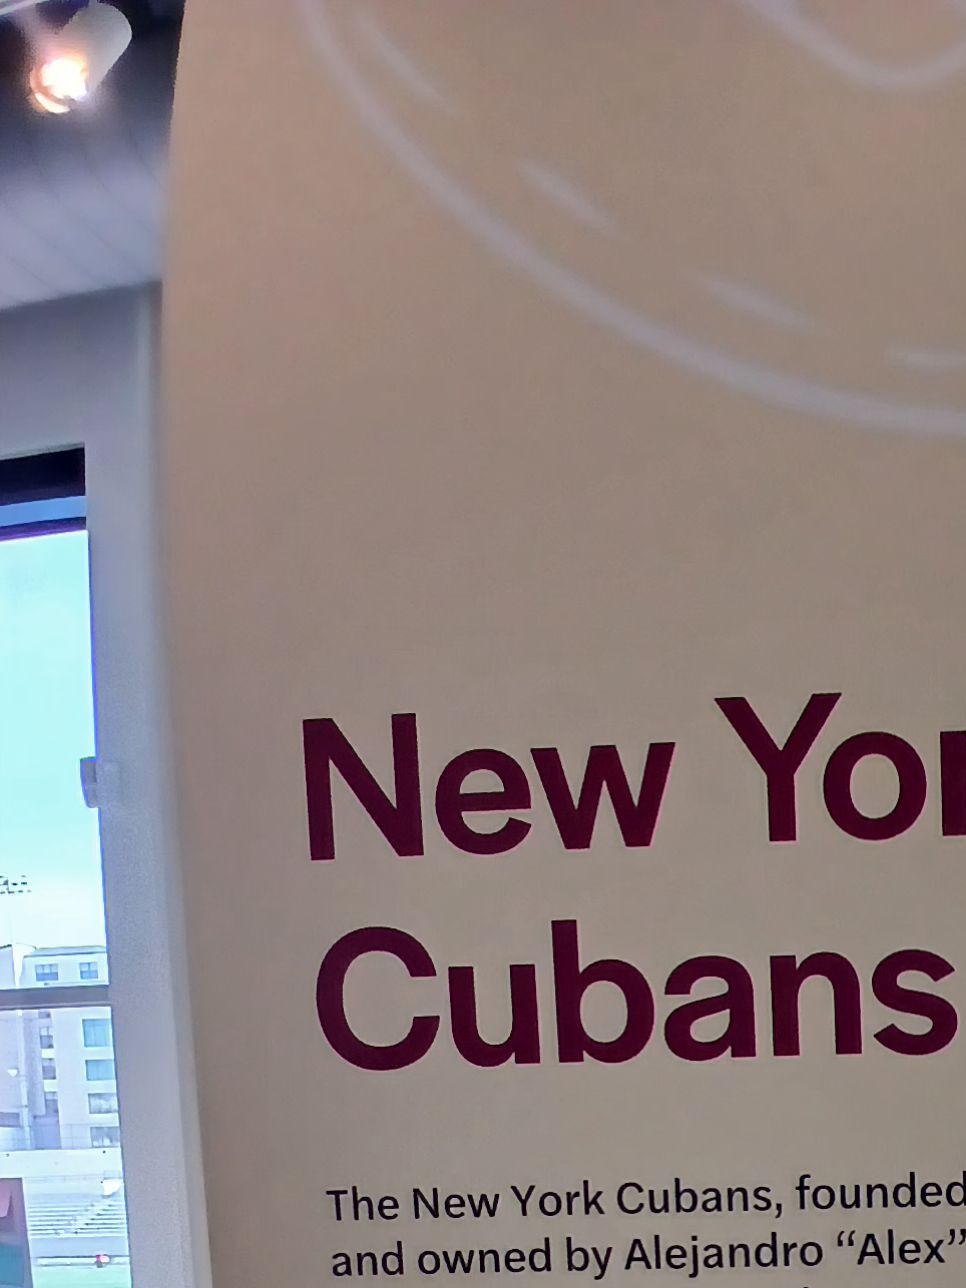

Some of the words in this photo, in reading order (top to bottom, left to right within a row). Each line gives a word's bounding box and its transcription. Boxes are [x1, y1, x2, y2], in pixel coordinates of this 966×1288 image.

[302, 713, 676, 861] New
[316, 919, 958, 1071] Cubans
[326, 1186, 399, 1221] The
[413, 1188, 499, 1219] New
[511, 1180, 605, 1216] York
[617, 1178, 782, 1218] Cubans,
[332, 1241, 404, 1276] and
[418, 1237, 551, 1274] owned
[566, 1237, 612, 1280] by
[625, 1232, 823, 1278] Alejandro
[837, 1229, 966, 1265] “Alex”
